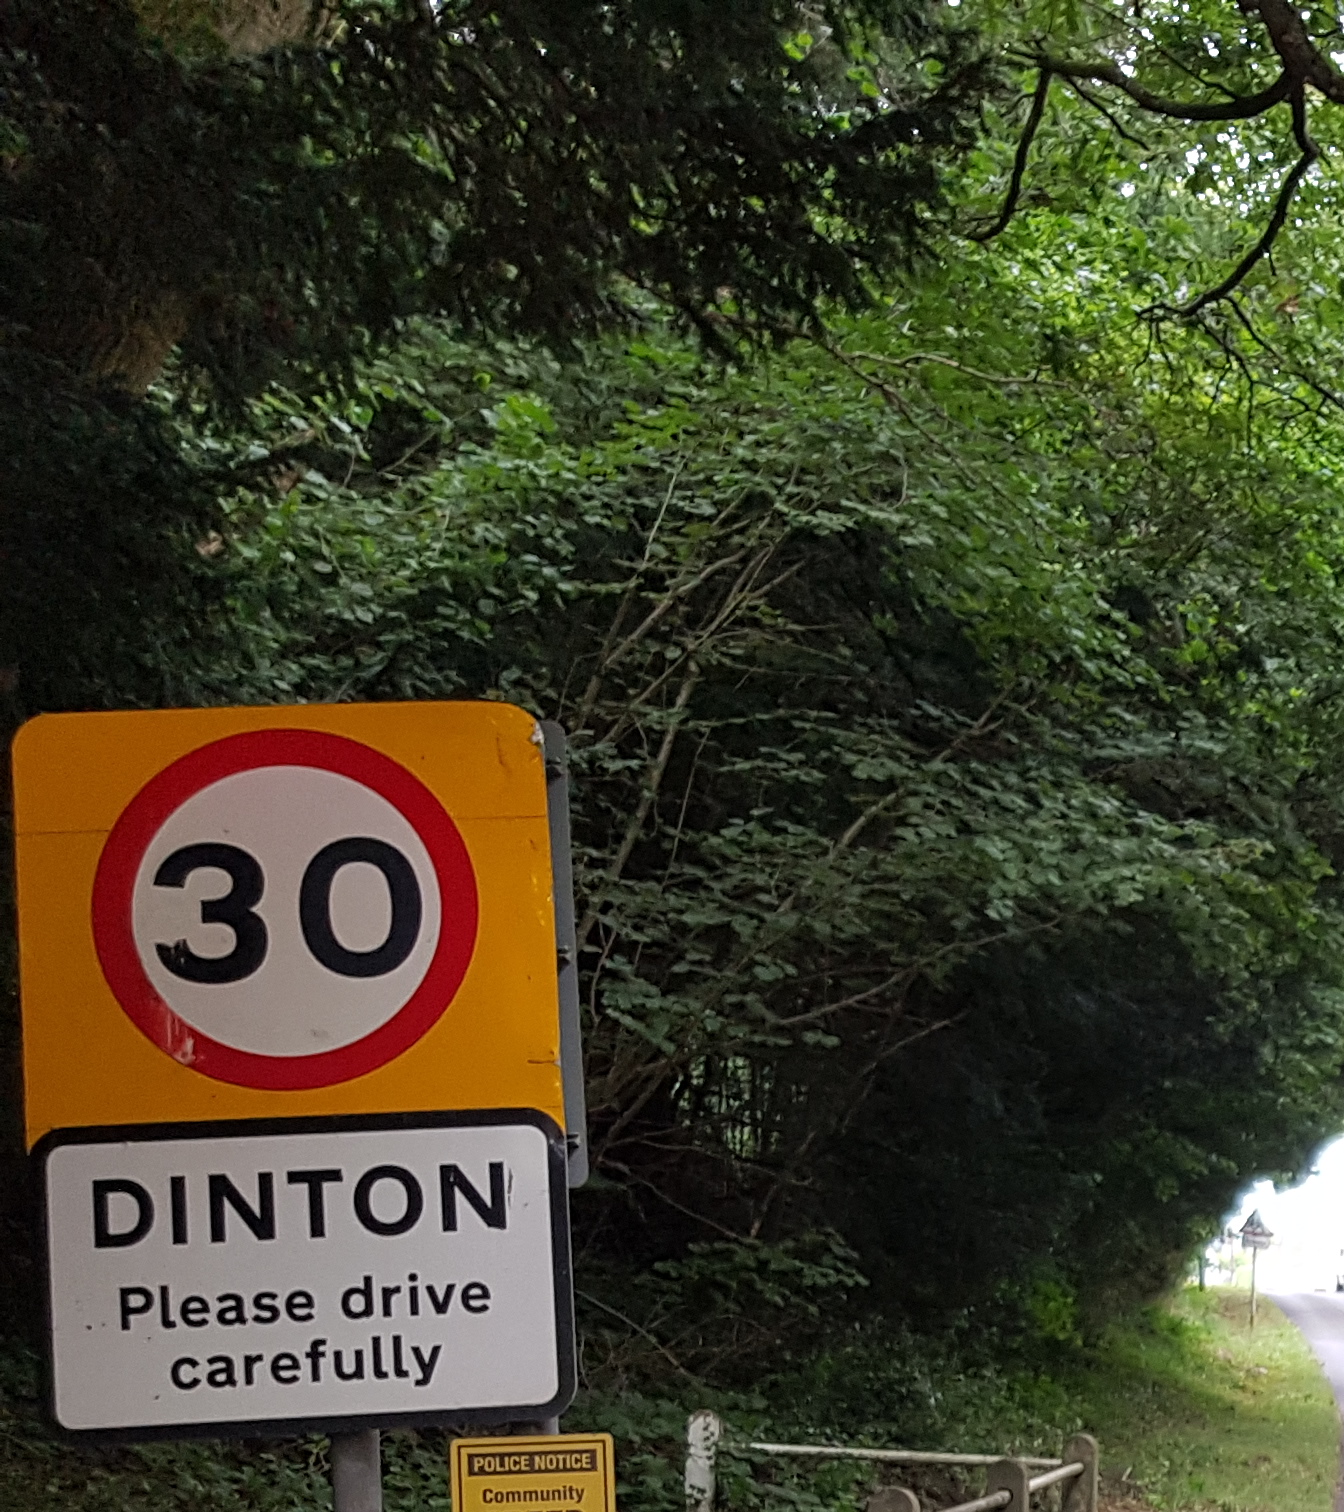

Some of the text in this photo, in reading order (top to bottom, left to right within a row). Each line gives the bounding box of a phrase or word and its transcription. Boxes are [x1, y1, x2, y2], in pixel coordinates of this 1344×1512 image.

[151, 836, 423, 984] 30
[91, 1161, 508, 1249] DINTON
[118, 1273, 491, 1331] Please drive
[170, 1336, 441, 1390] carefully
[473, 1452, 592, 1472] POLICE NOTICE
[482, 1485, 585, 1504] Community
